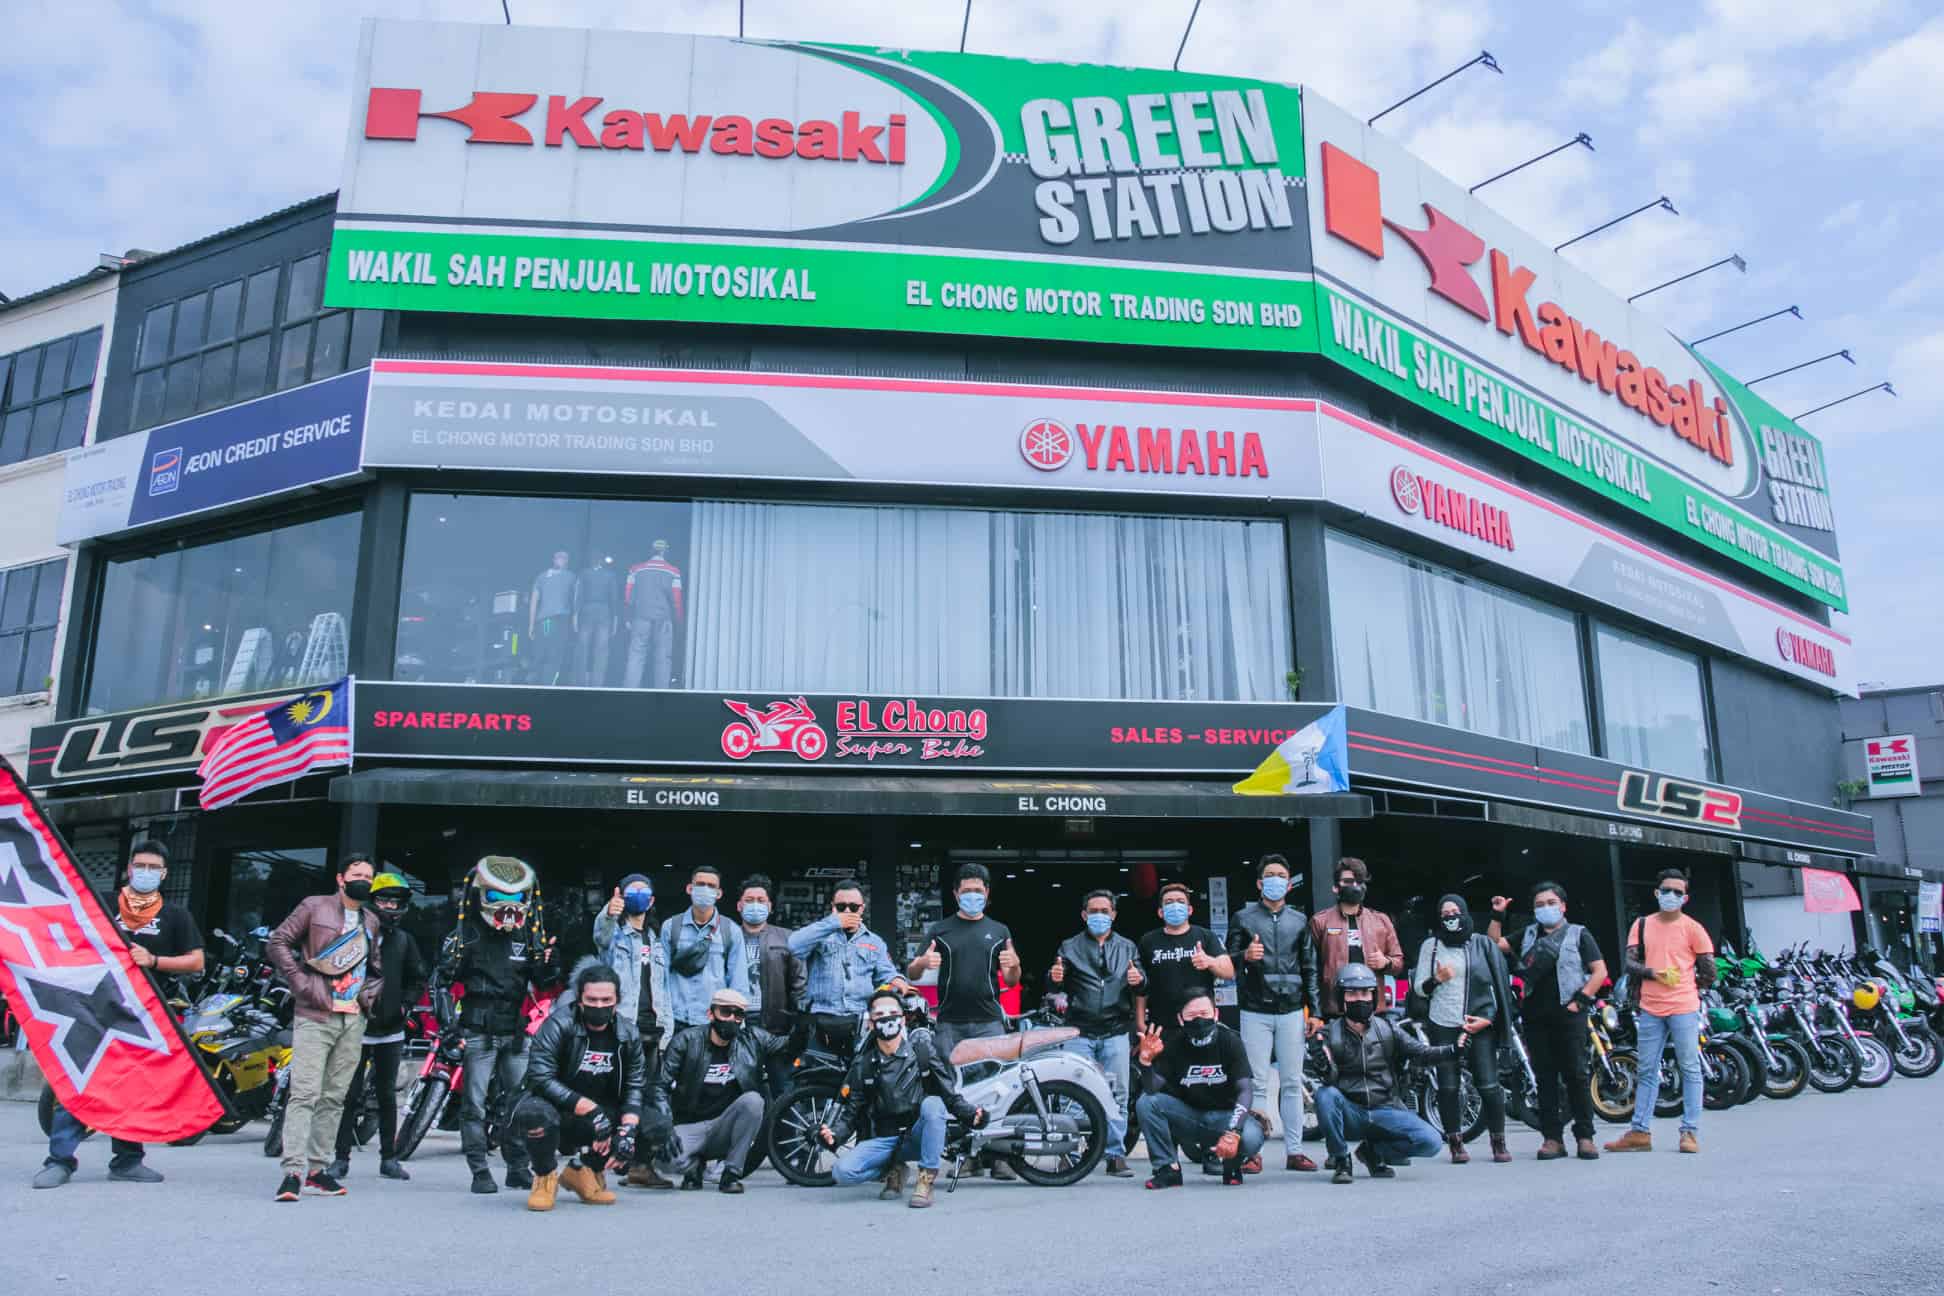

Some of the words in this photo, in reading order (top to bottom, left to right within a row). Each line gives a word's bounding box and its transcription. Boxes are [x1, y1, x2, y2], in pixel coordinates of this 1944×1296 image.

[545, 95, 906, 165] Kawasaki
[1020, 89, 1280, 179] GREEN
[1035, 168, 1294, 245] STATION
[348, 250, 437, 285] WAKIL
[447, 254, 506, 287] SAH
[512, 257, 640, 294] PENJUAL
[650, 263, 816, 301] MOTOSIKAL
[906, 280, 933, 306] EL
[941, 282, 1018, 311] CHONG
[1025, 288, 1101, 316] MOTOR
[1109, 293, 1205, 324] TRADING
[1212, 301, 1254, 326] SDN
[1260, 303, 1301, 328] BHD
[1489, 247, 1734, 468] Kawasaki
[413, 399, 512, 420] KEDAI
[527, 403, 717, 427] MOTOSIKAL
[1328, 293, 1408, 381] WAKIL
[1412, 340, 1460, 407] SAH
[1464, 366, 1553, 452] PENJUAL
[1555, 415, 1651, 502] MOTOSIKAL
[225, 433, 281, 464] CREDIT
[282, 414, 352, 449] SERVICE
[411, 429, 432, 445] EL
[437, 430, 496, 447] CHONG
[500, 432, 561, 448] MOTOR
[563, 434, 637, 451] TRADING
[640, 437, 675, 453] SDN
[680, 438, 714, 454] BHD
[1075, 423, 1270, 478] YAMAHA
[1759, 423, 1825, 490] GREEN
[1416, 474, 1515, 552] YAMAHA
[1702, 503, 1736, 545] CHONG
[1768, 479, 1834, 533] STATION
[1789, 632, 1836, 678] YAMAHA
[373, 711, 532, 731] SPAREPARTS
[836, 700, 878, 732] EL
[882, 698, 988, 741] Chong
[1110, 727, 1184, 744] SALES
[835, 736, 913, 760] Super
[920, 737, 985, 760] Bike
[627, 789, 648, 805] EL
[656, 790, 720, 806] CHONG
[1018, 797, 1039, 811] EL
[1045, 796, 1106, 812] CHONG
[1617, 770, 1743, 830] LS2
